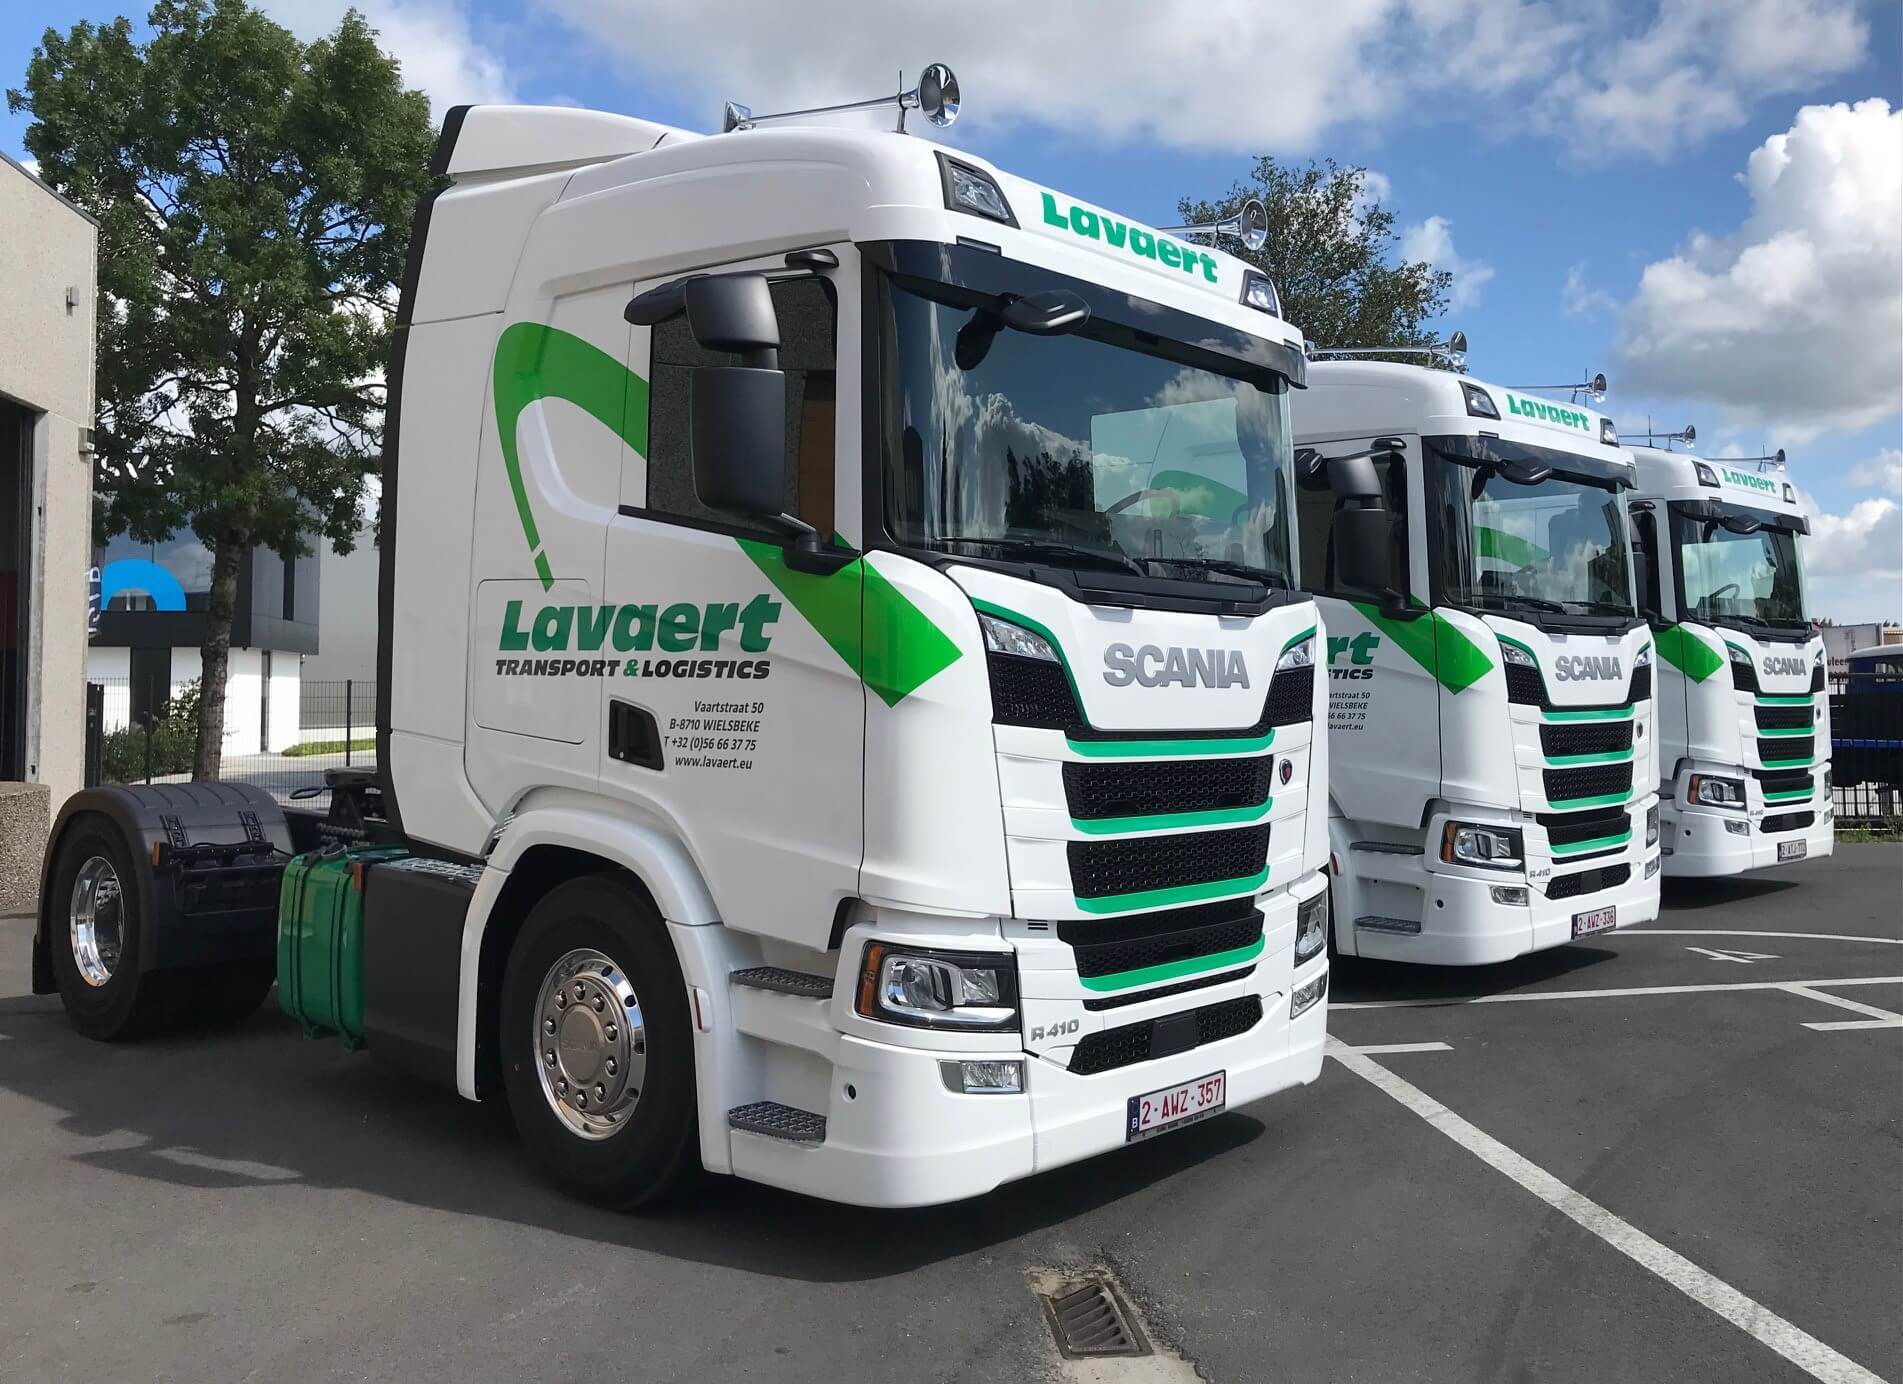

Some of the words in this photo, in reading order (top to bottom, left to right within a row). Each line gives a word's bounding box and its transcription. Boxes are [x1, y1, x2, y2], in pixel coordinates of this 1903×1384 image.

[1040, 191, 1218, 283] Lavaert
[1506, 393, 1590, 431] Lavaert
[1719, 467, 1777, 493] Lavaert
[499, 593, 782, 653] Lavaert
[495, 658, 620, 677] TRANSPORT
[623, 658, 639, 677] &
[642, 660, 771, 680] LOGISTICS
[1102, 642, 1250, 689] SCANIA
[1555, 655, 1623, 682] SCANIA
[1762, 655, 1807, 677] SCANIA
[1361, 691, 1371, 699] 50
[694, 700, 750, 713] Vaartstraat
[751, 702, 764, 714] 50
[669, 718, 701, 731] B-8710
[703, 719, 761, 732] WIELSBEKE
[664, 736, 670, 748] T
[671, 737, 688, 749] +32
[690, 736, 715, 751] (0)56
[716, 738, 729, 750] 66
[730, 739, 743, 751] 37
[744, 739, 757, 751] 75
[674, 755, 753, 770] www.lavaert.eu
[1030, 1026, 1045, 1042] R
[1046, 1018, 1080, 1038] 410
[1131, 1117, 1138, 1129] B
